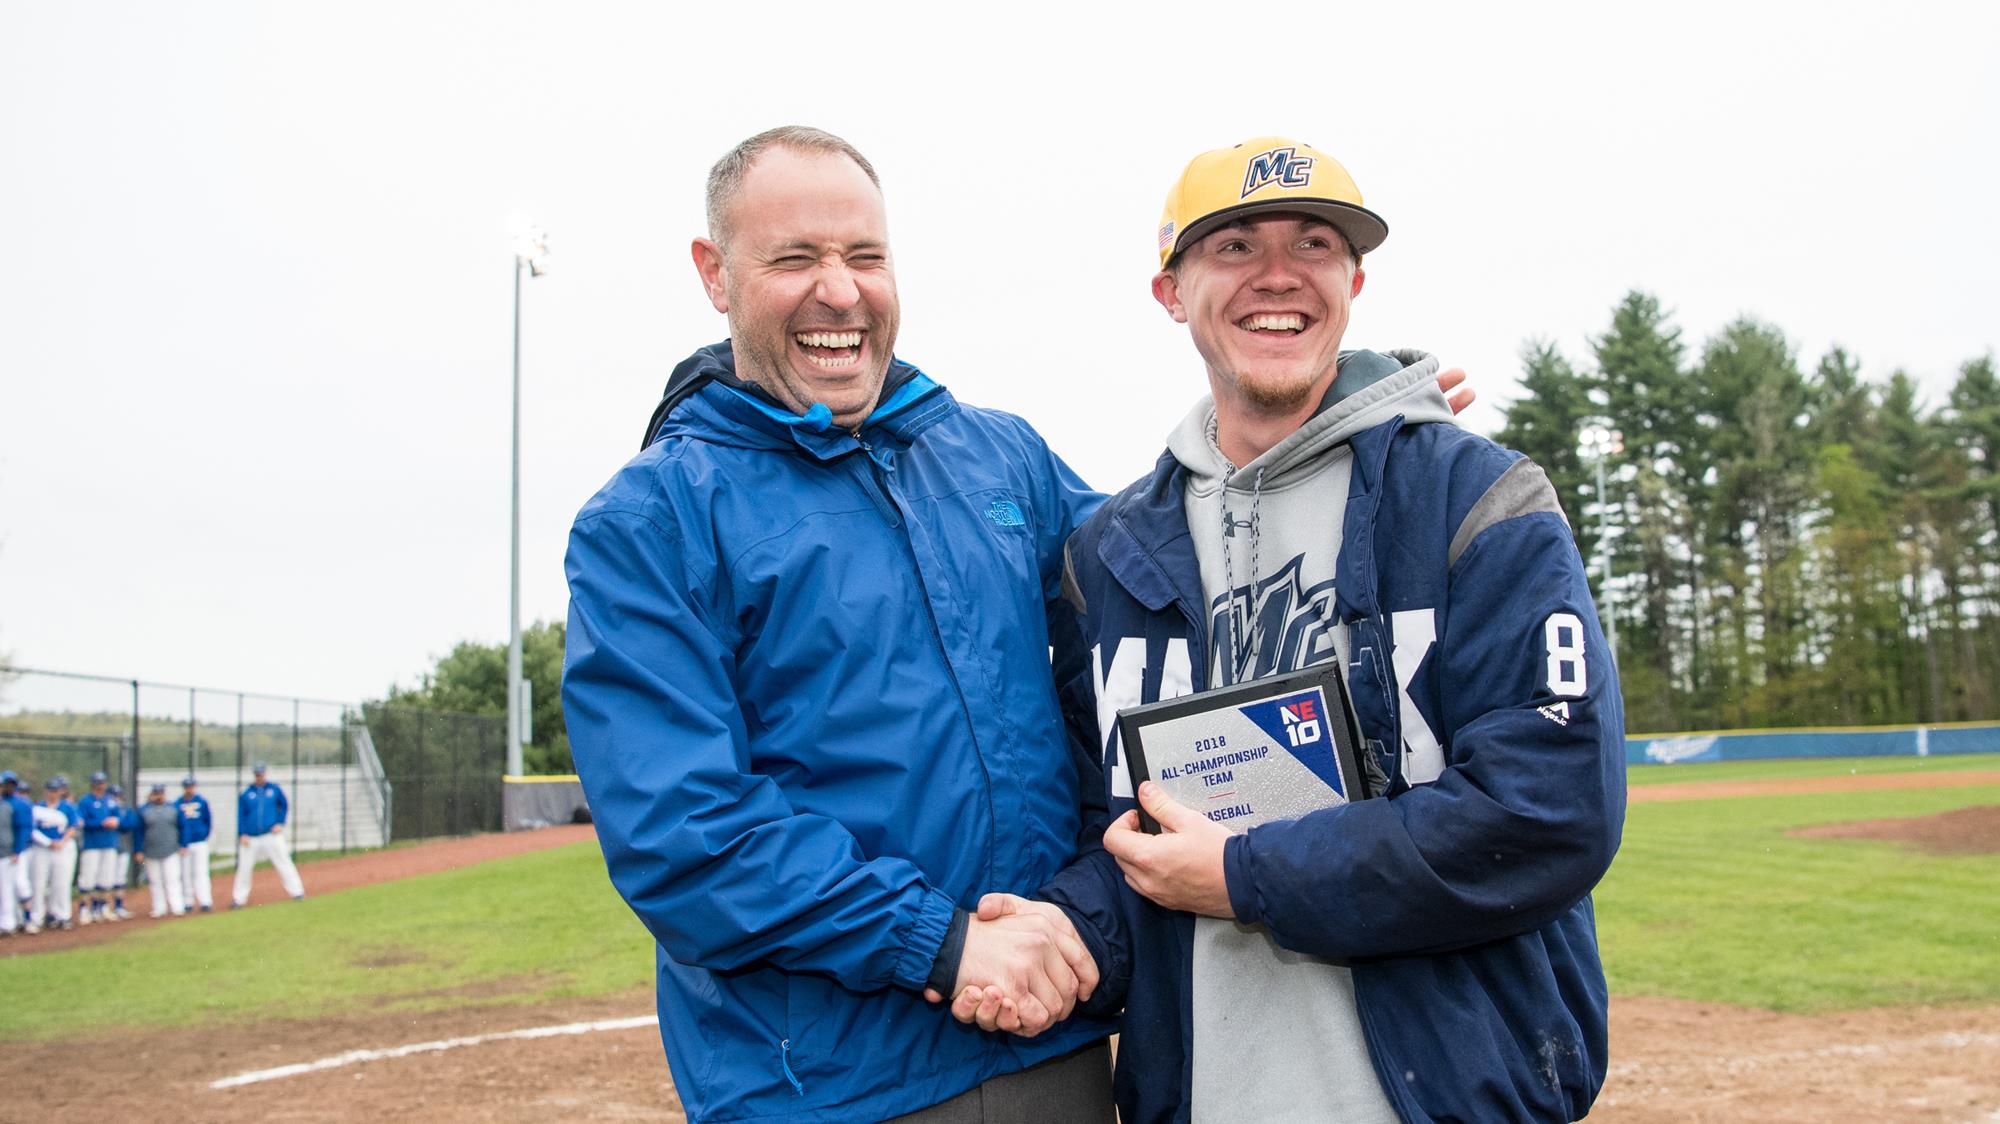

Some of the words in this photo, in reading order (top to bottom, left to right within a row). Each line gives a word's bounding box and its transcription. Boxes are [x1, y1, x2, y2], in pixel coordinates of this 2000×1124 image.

[1242, 148, 1312, 197] MC
[1545, 612, 1587, 696] 8
[1280, 699, 1318, 725] NE
[1195, 735, 1226, 753] 2018
[1286, 719, 1321, 747] 10
[1161, 746, 1269, 780] ALL-CHAMPIONSHIP
[1202, 770, 1234, 787] TEAM
[1202, 803, 1255, 822] ASEBALL
